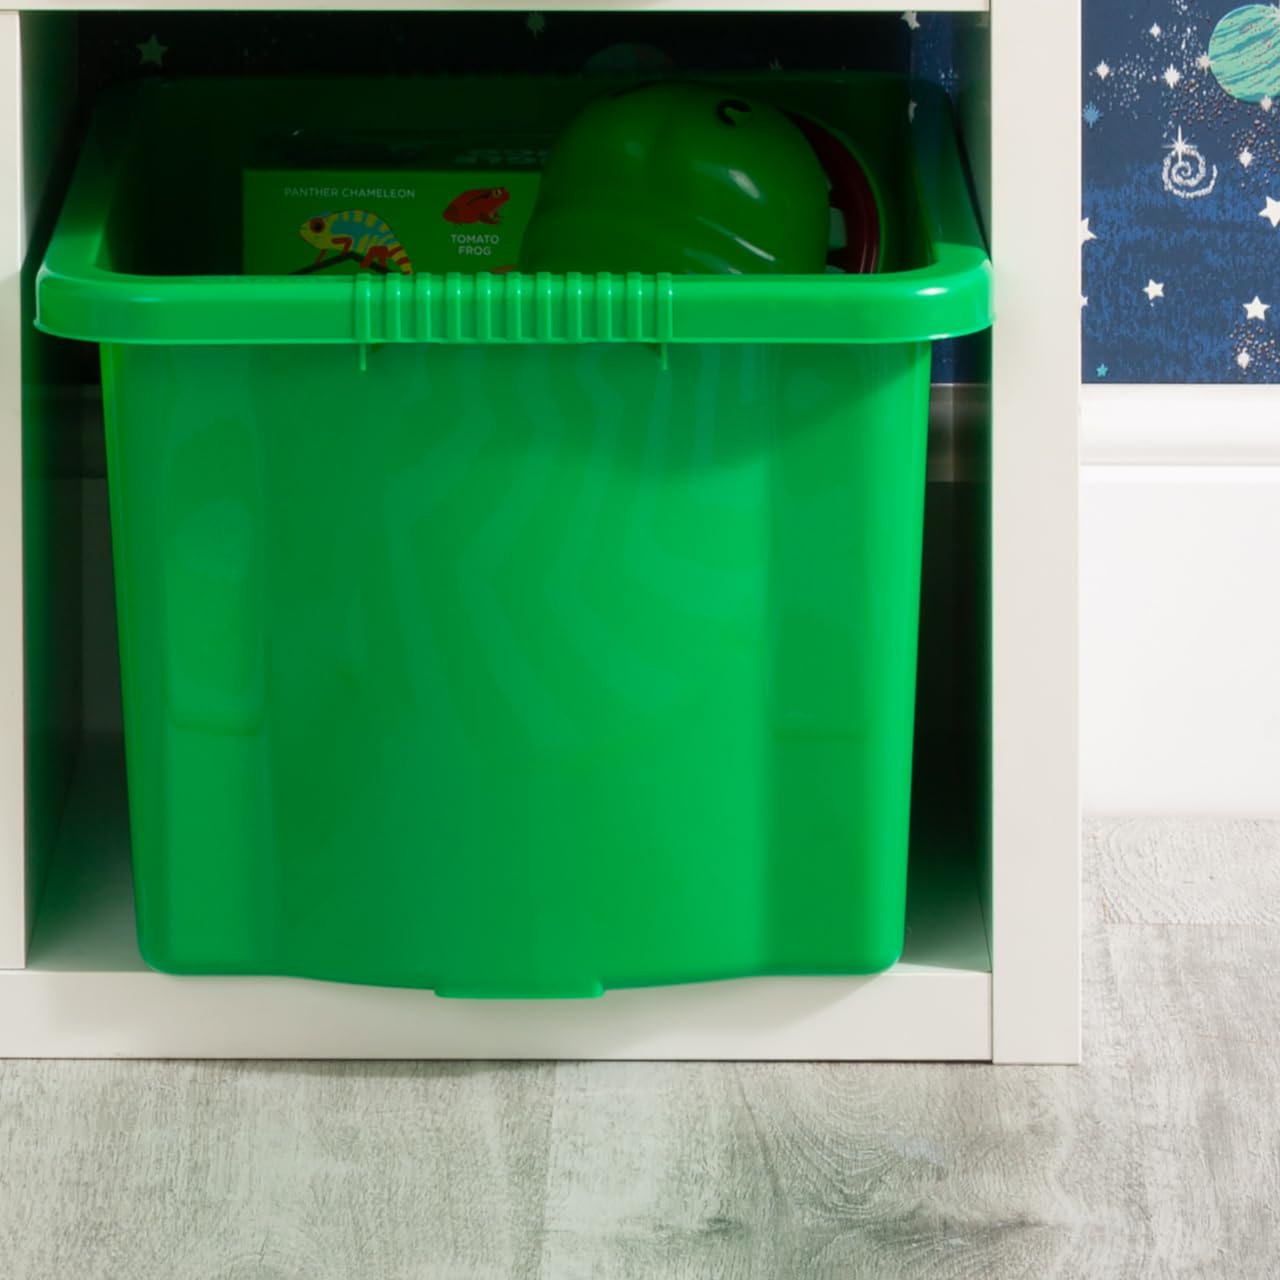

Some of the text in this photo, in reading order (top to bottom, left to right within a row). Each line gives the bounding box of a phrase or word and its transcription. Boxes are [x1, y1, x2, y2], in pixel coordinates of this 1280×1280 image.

[284, 186, 416, 199] PANTHER CHAMELEON
[450, 233, 500, 245] TOMATO
[458, 244, 492, 256] FROG
